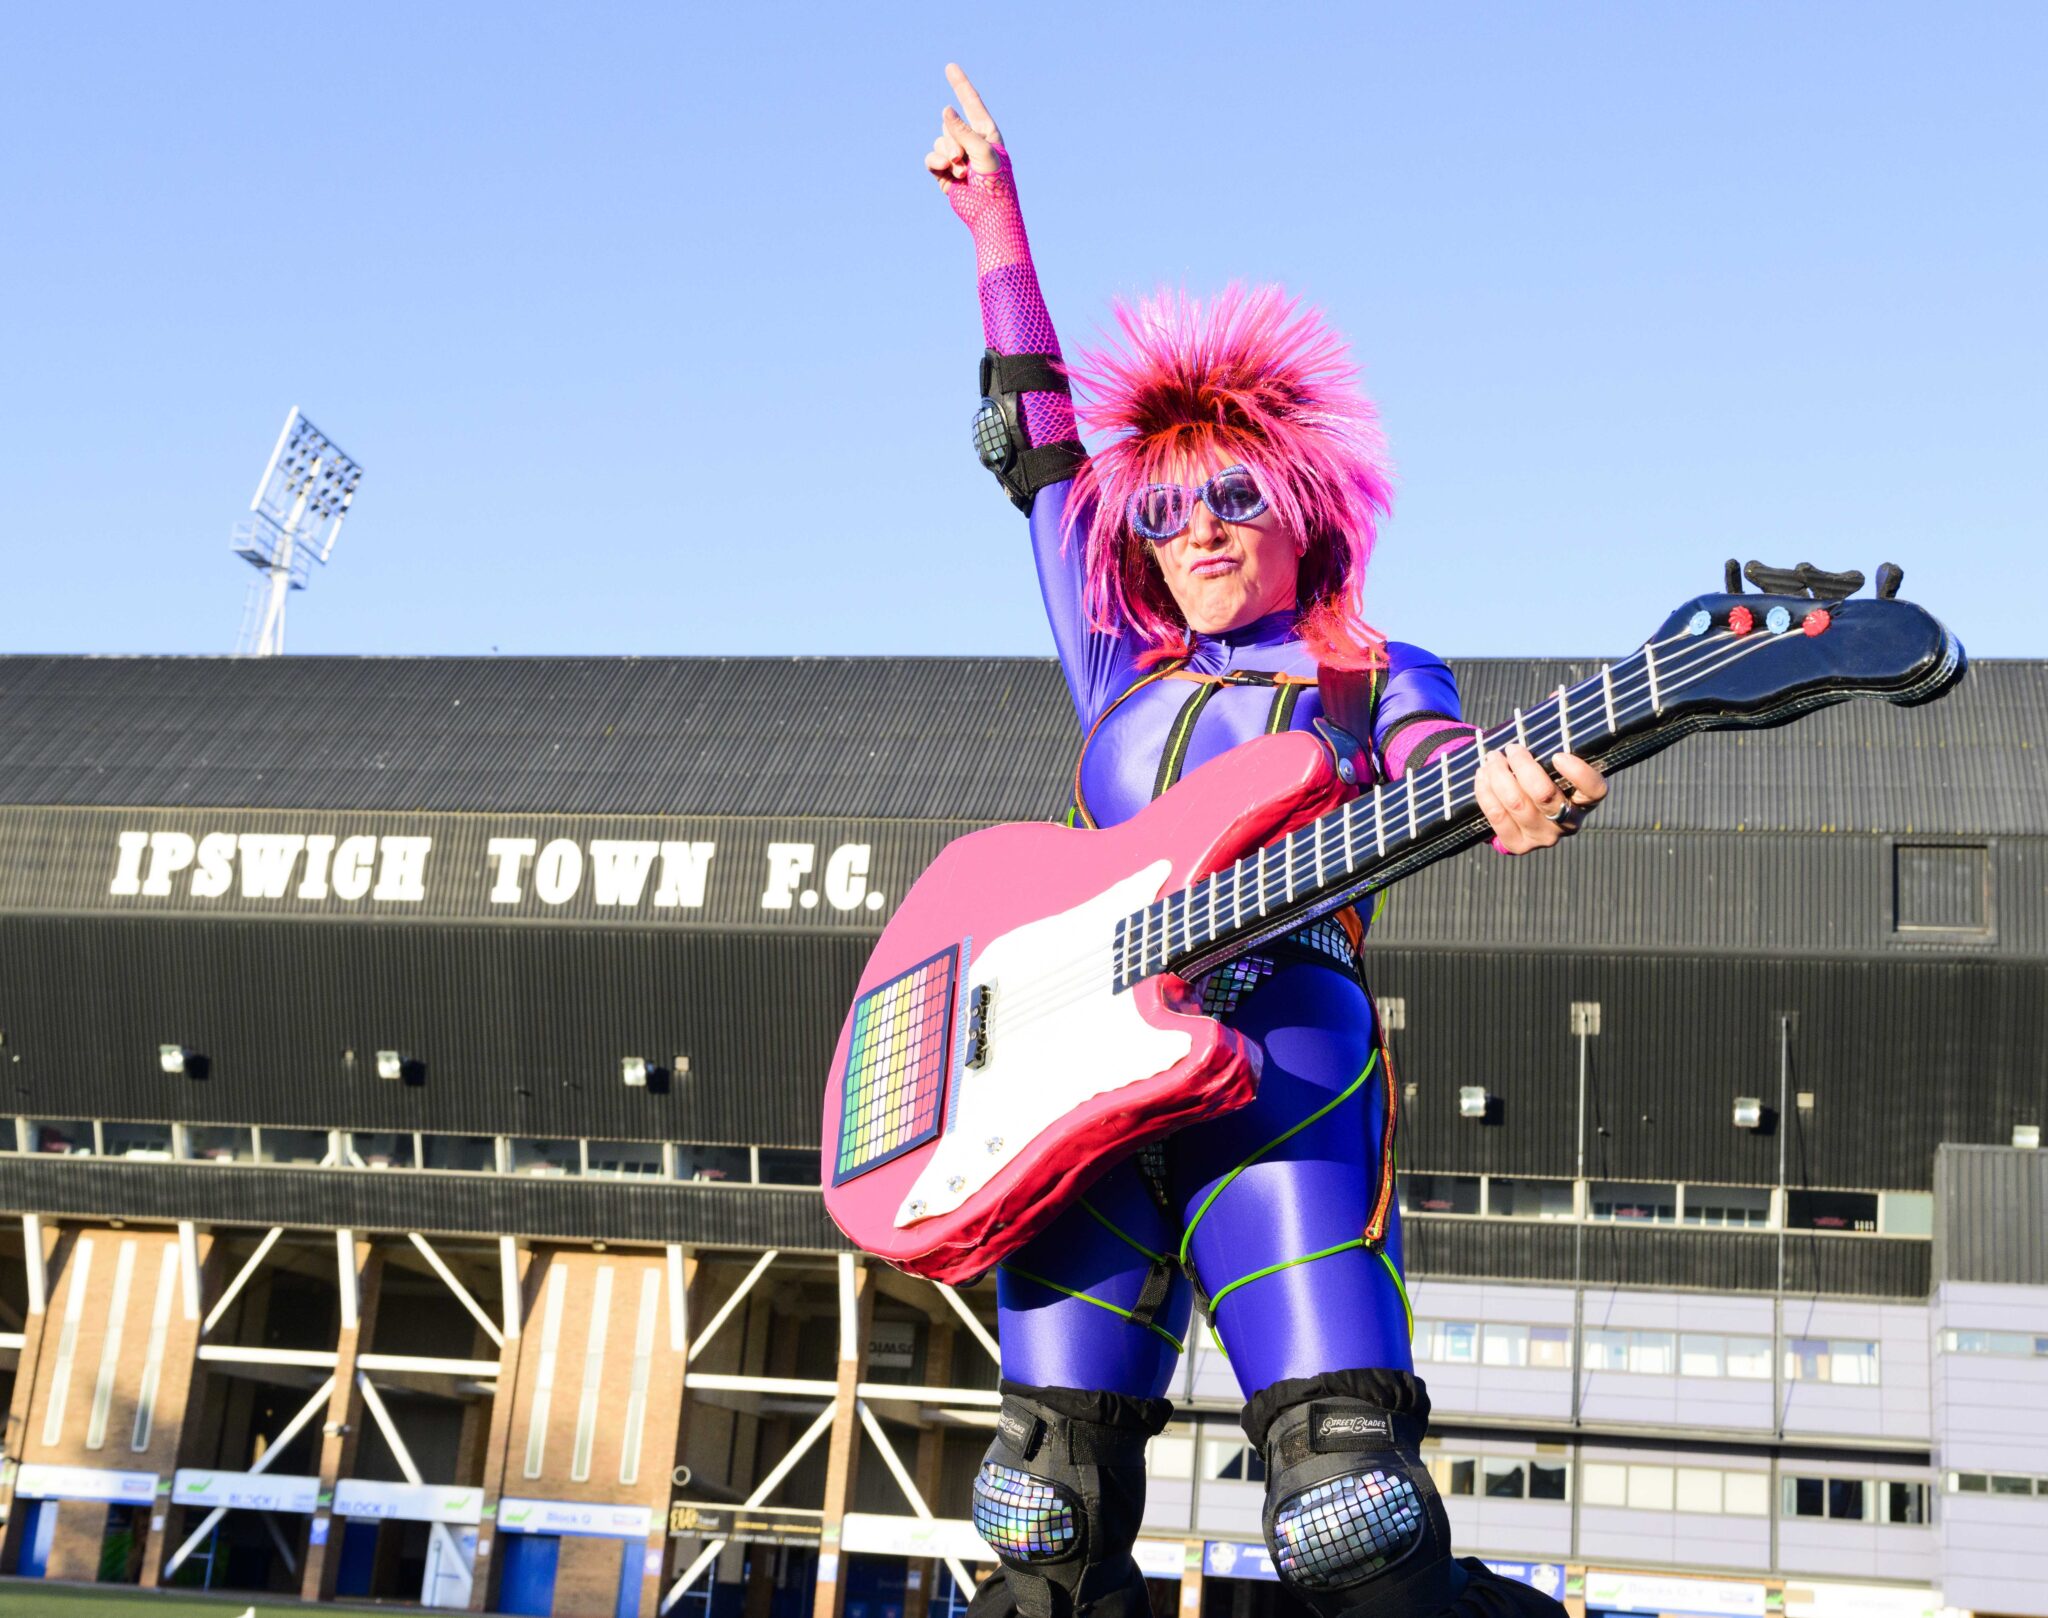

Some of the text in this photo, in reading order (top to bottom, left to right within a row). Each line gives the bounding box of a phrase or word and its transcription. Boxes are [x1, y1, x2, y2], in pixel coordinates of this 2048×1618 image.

[110, 831, 886, 912] IPSWICH TOWN F.C.
[339, 1501, 381, 1516] BLOCK
